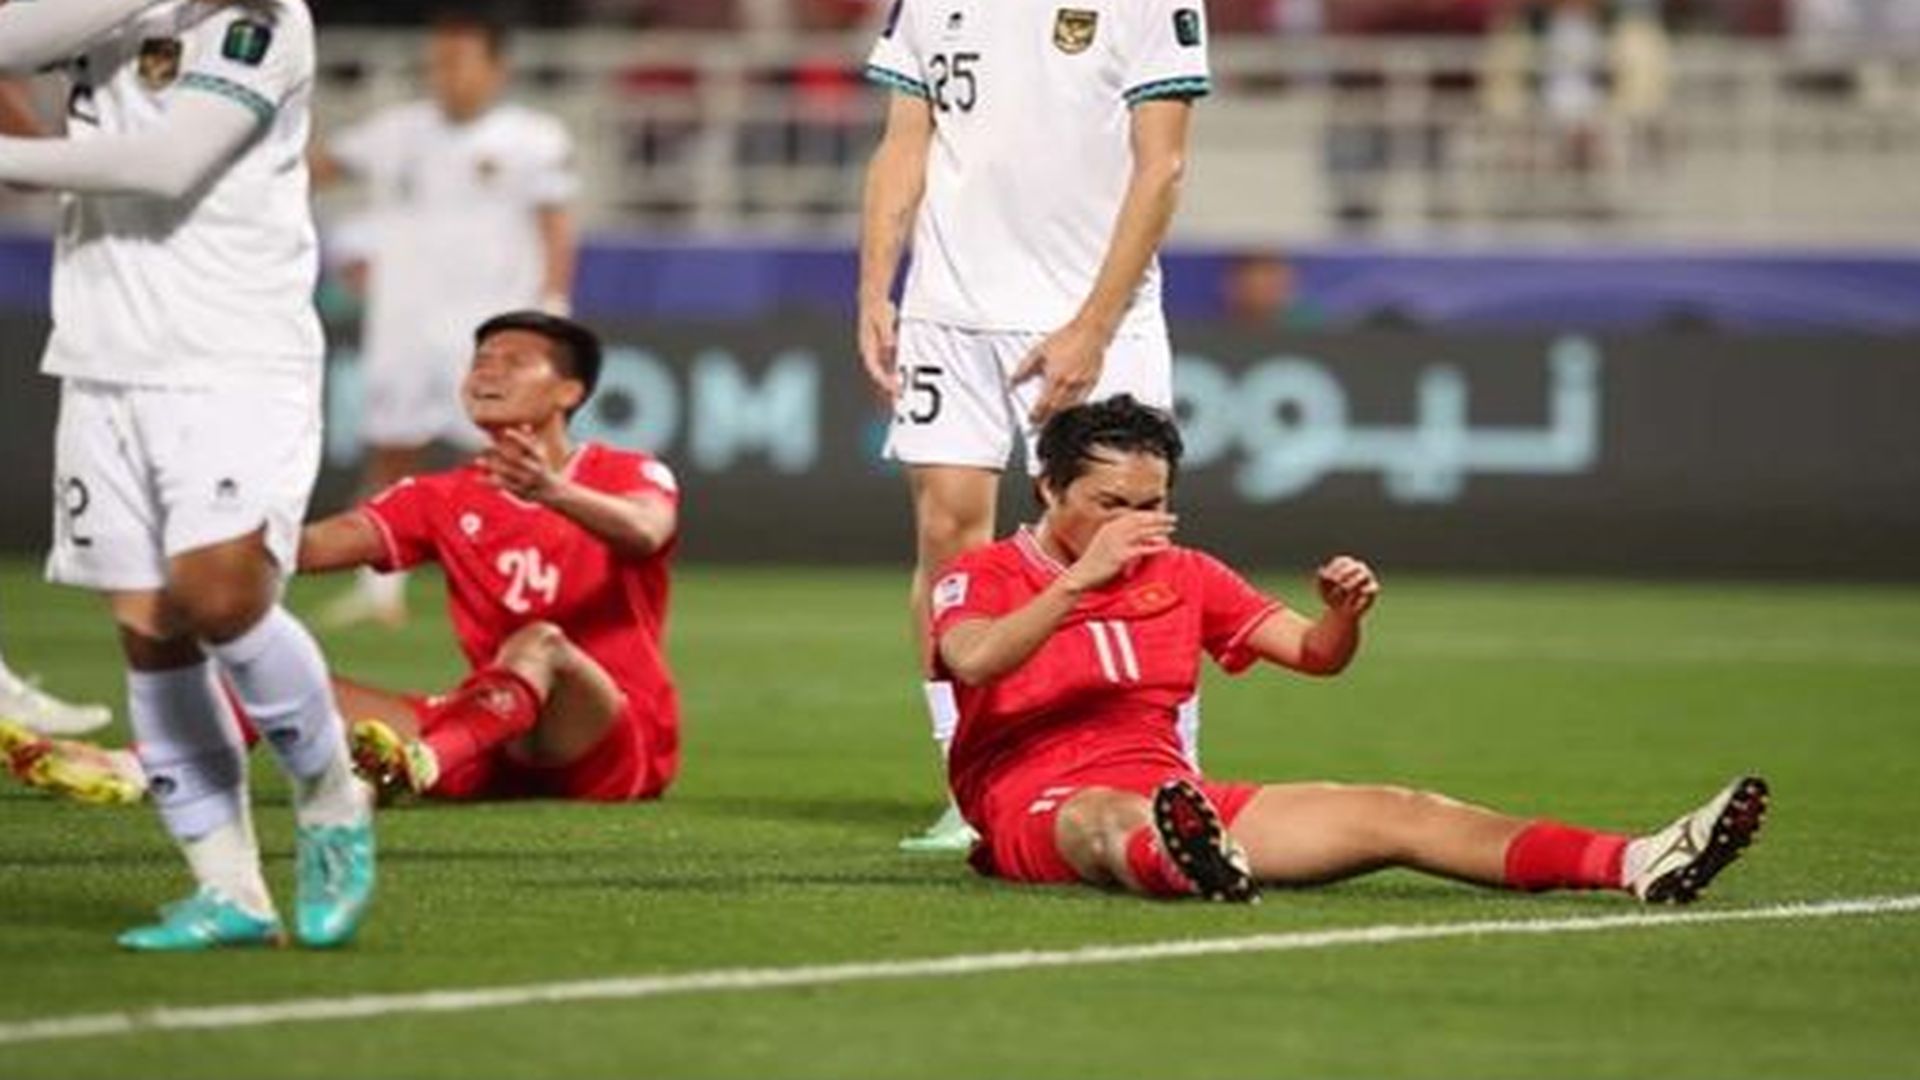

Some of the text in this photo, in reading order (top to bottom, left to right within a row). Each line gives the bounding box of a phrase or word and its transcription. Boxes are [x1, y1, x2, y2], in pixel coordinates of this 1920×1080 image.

[929, 53, 980, 112] 25
[497, 548, 560, 613] 24
[1087, 620, 1140, 682] 11
